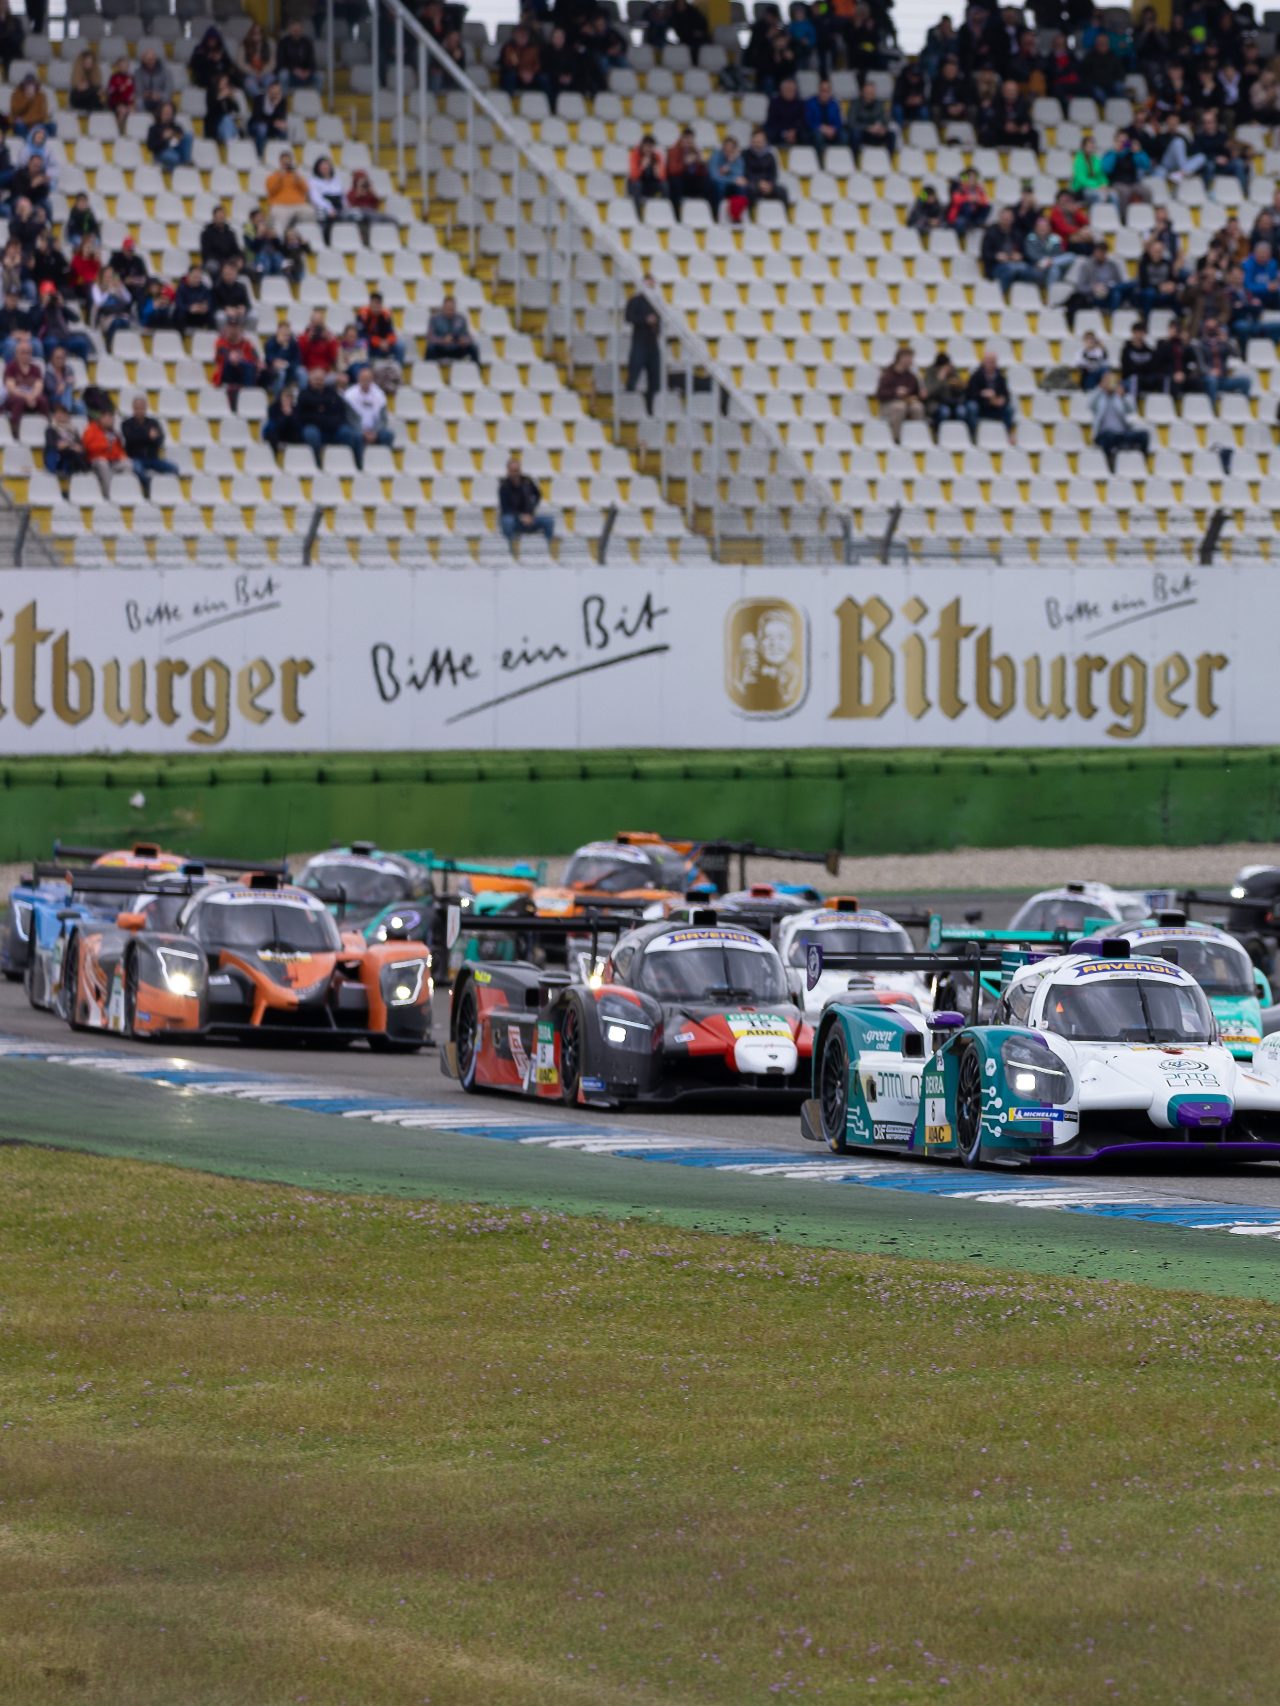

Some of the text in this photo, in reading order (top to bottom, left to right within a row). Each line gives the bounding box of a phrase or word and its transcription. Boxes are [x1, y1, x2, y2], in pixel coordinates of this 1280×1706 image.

[125, 576, 280, 633] Bitte ein Bit
[1045, 597, 1101, 629] Bitte
[1153, 573, 1198, 600] Bit
[0, 598, 315, 745] tburger
[371, 592, 670, 703] Bitte ein Bit
[827, 594, 1230, 740] Bitburger
[1082, 962, 1177, 976] RAVENOL
[1023, 1111, 1060, 1119] MICHELIN
